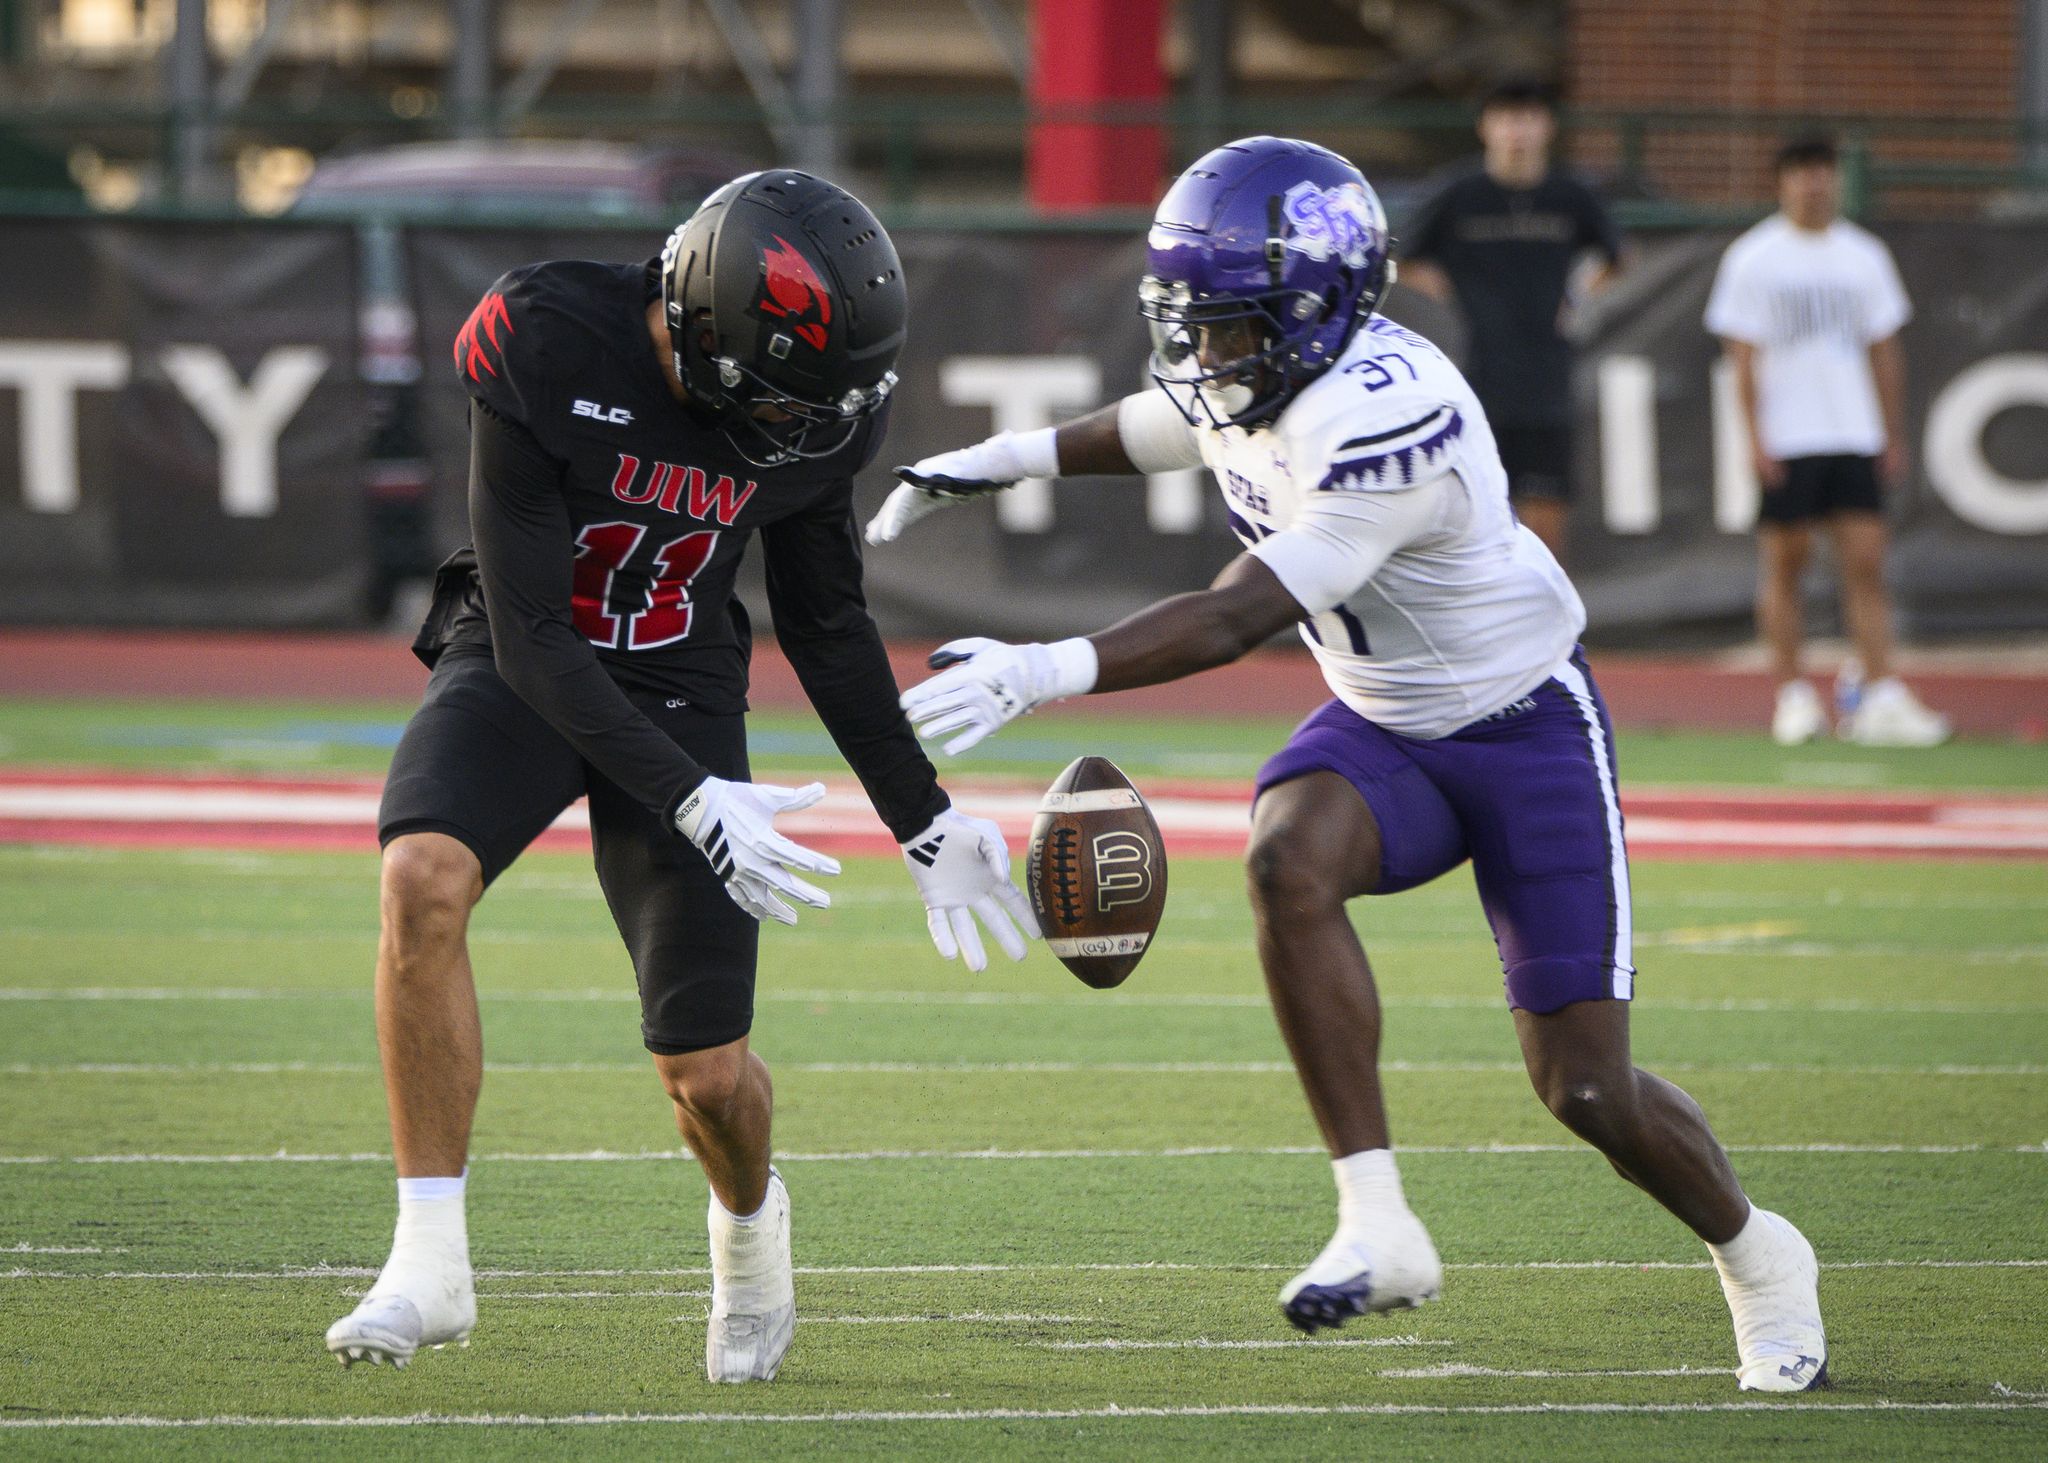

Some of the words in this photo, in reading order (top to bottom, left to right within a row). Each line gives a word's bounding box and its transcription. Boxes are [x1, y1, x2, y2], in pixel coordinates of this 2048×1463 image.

[571, 400, 634, 425] SLC
[611, 453, 758, 526] UIW
[571, 521, 722, 651] 11
[674, 795, 700, 822] ADIZERO
[1031, 837, 1045, 914] Wilson
